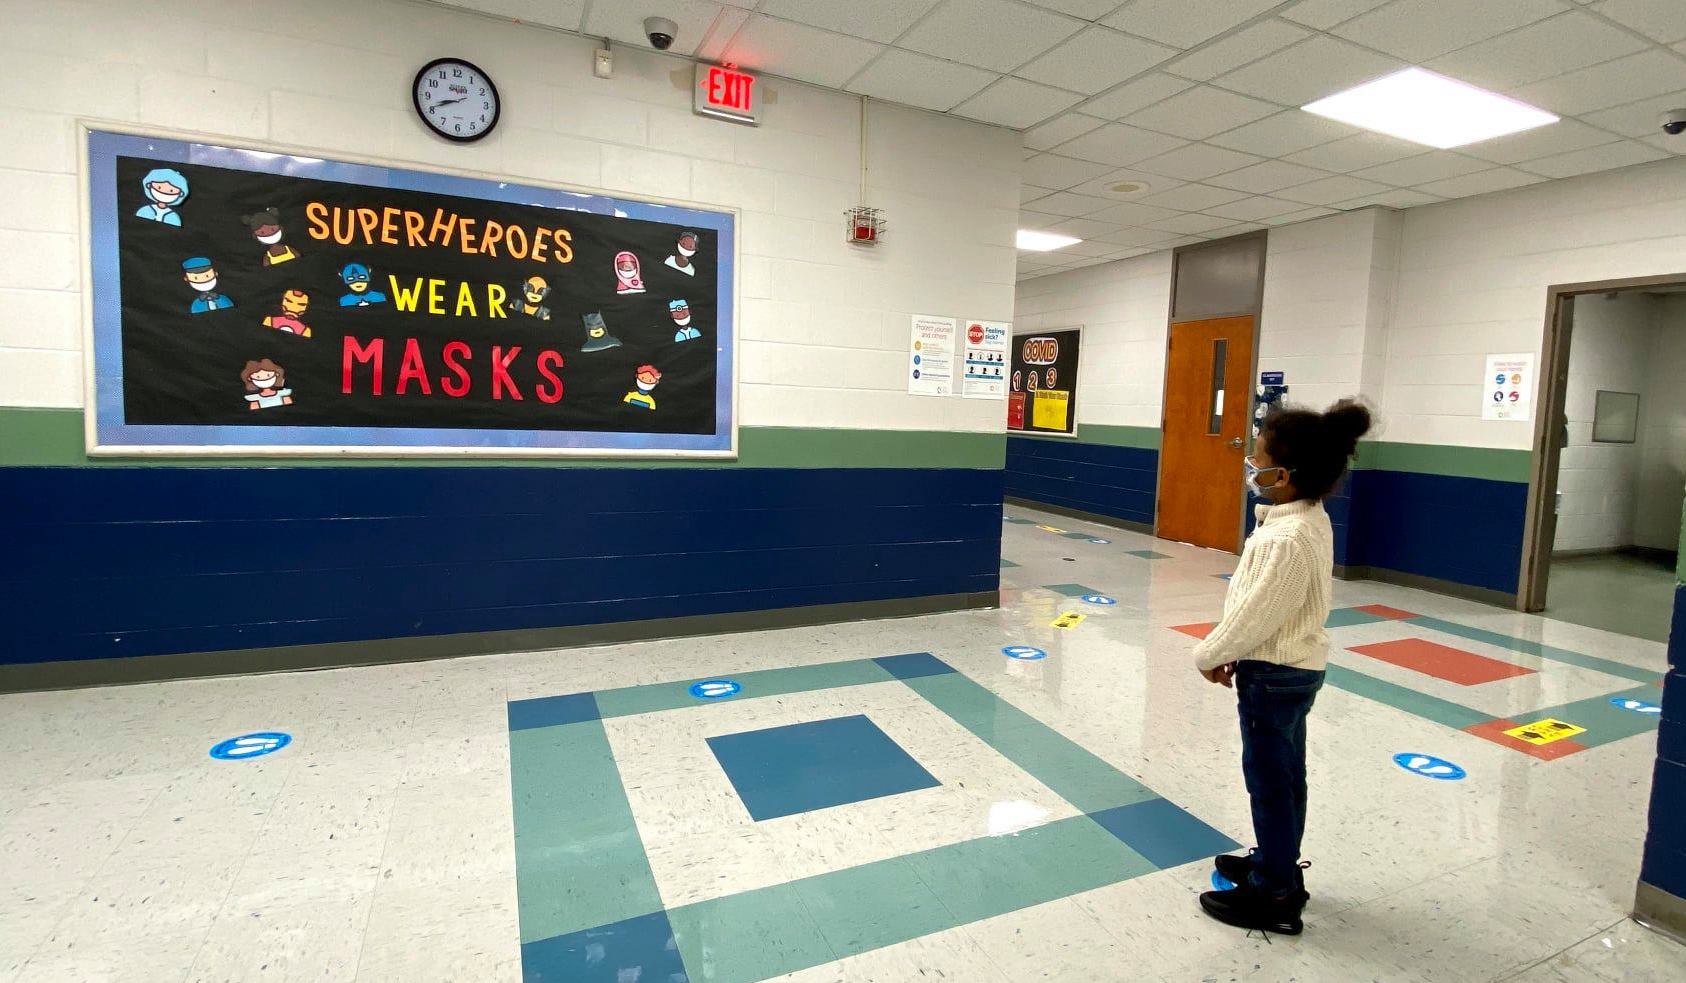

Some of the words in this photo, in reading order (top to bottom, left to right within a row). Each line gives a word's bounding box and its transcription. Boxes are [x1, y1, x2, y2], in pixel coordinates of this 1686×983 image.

[439, 71, 446, 79] 11
[453, 69, 462, 78] 12
[428, 79, 438, 88] 10
[469, 76, 473, 84] 1
[479, 88, 485, 96] 2
[708, 67, 753, 111] EXIT
[425, 92, 431, 100] 9
[429, 106, 435, 114] 8
[483, 102, 489, 110] 3
[441, 117, 446, 125] 7
[480, 114, 485, 122] 4
[455, 124, 460, 132] 6
[470, 122, 475, 130] 5
[305, 202, 574, 264] SUPERHEROES
[388, 274, 508, 319] WEAR
[985, 327, 1005, 336] Feeling
[1024, 340, 1057, 362] COVID
[341, 335, 565, 404] MASKS
[1013, 372, 1021, 390] 1
[1028, 373, 1037, 390] 2
[1046, 369, 1057, 388] 3
